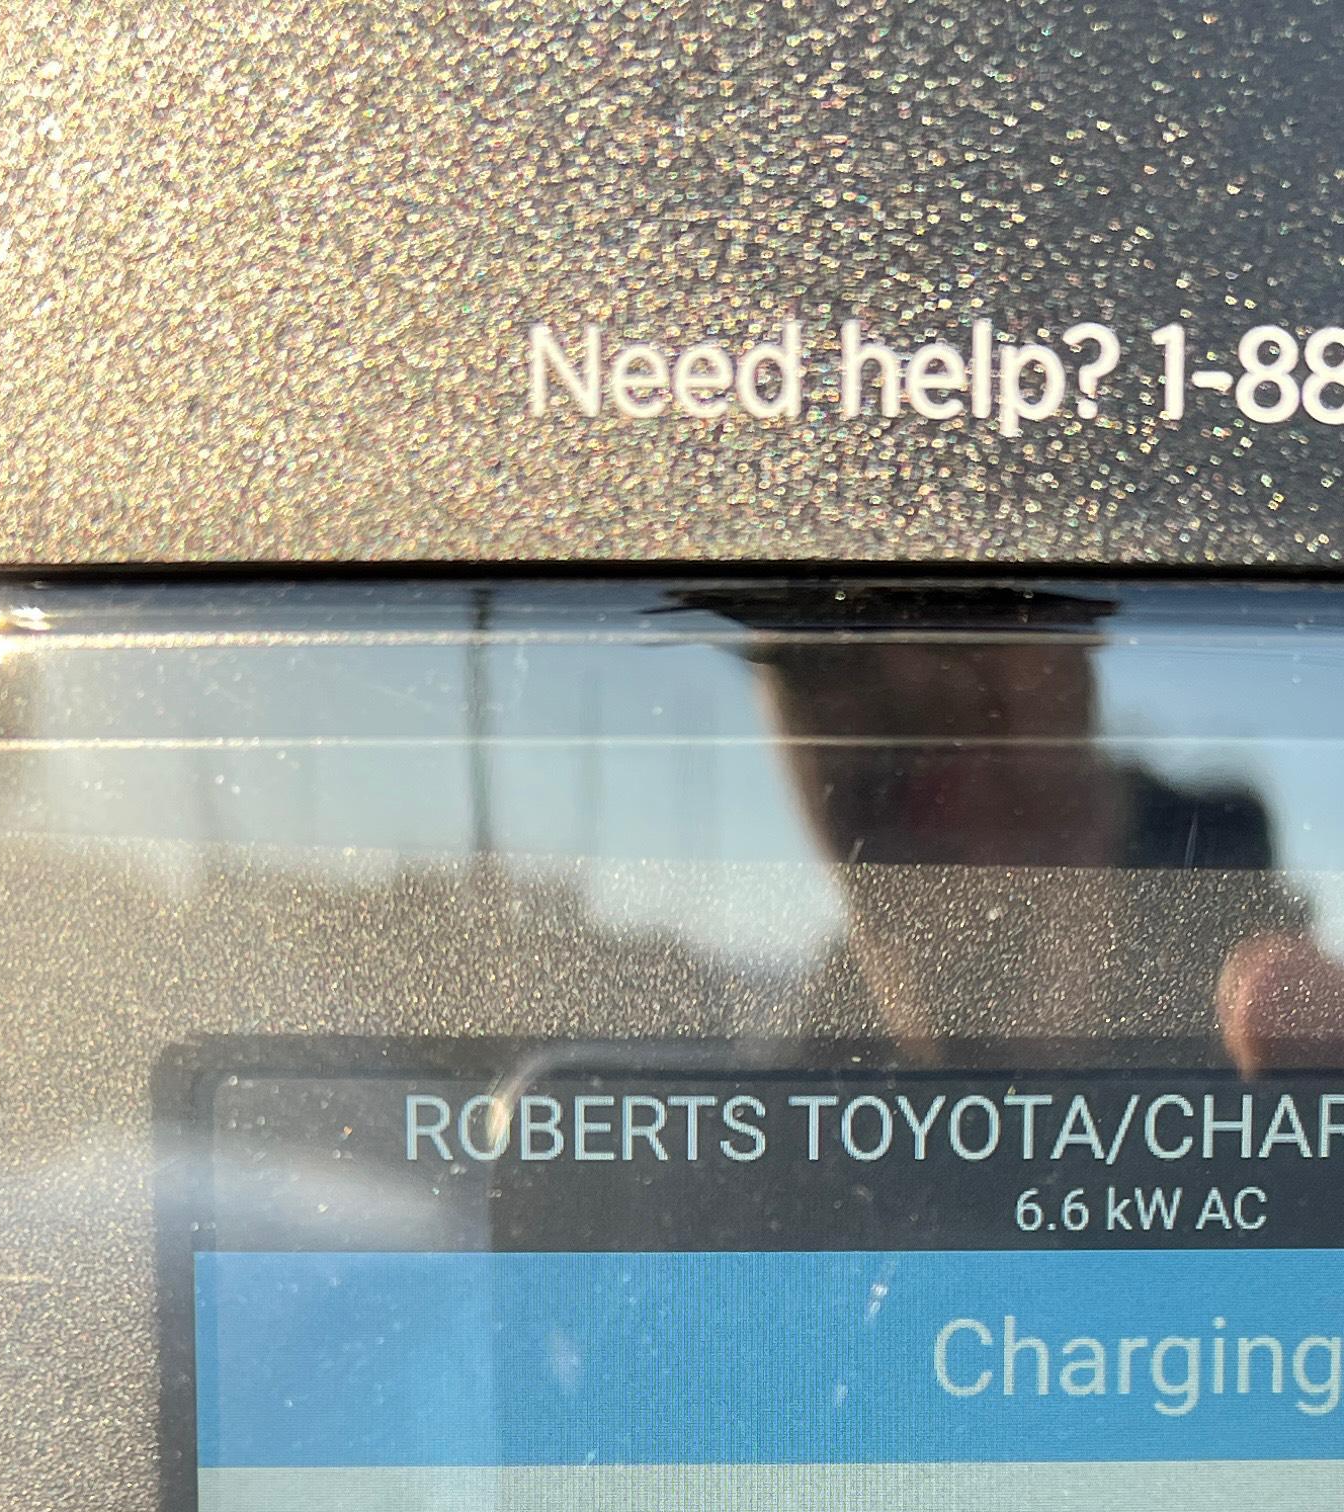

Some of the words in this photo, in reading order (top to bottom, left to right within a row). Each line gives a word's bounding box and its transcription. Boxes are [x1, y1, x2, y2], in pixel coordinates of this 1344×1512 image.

[529, 325, 801, 419] Need
[842, 320, 1120, 437] help?
[403, 1094, 767, 1162] ROBERTS
[1013, 1185, 1091, 1233] 6.6
[1104, 1184, 1185, 1233] kW
[1194, 1184, 1269, 1233] AC
